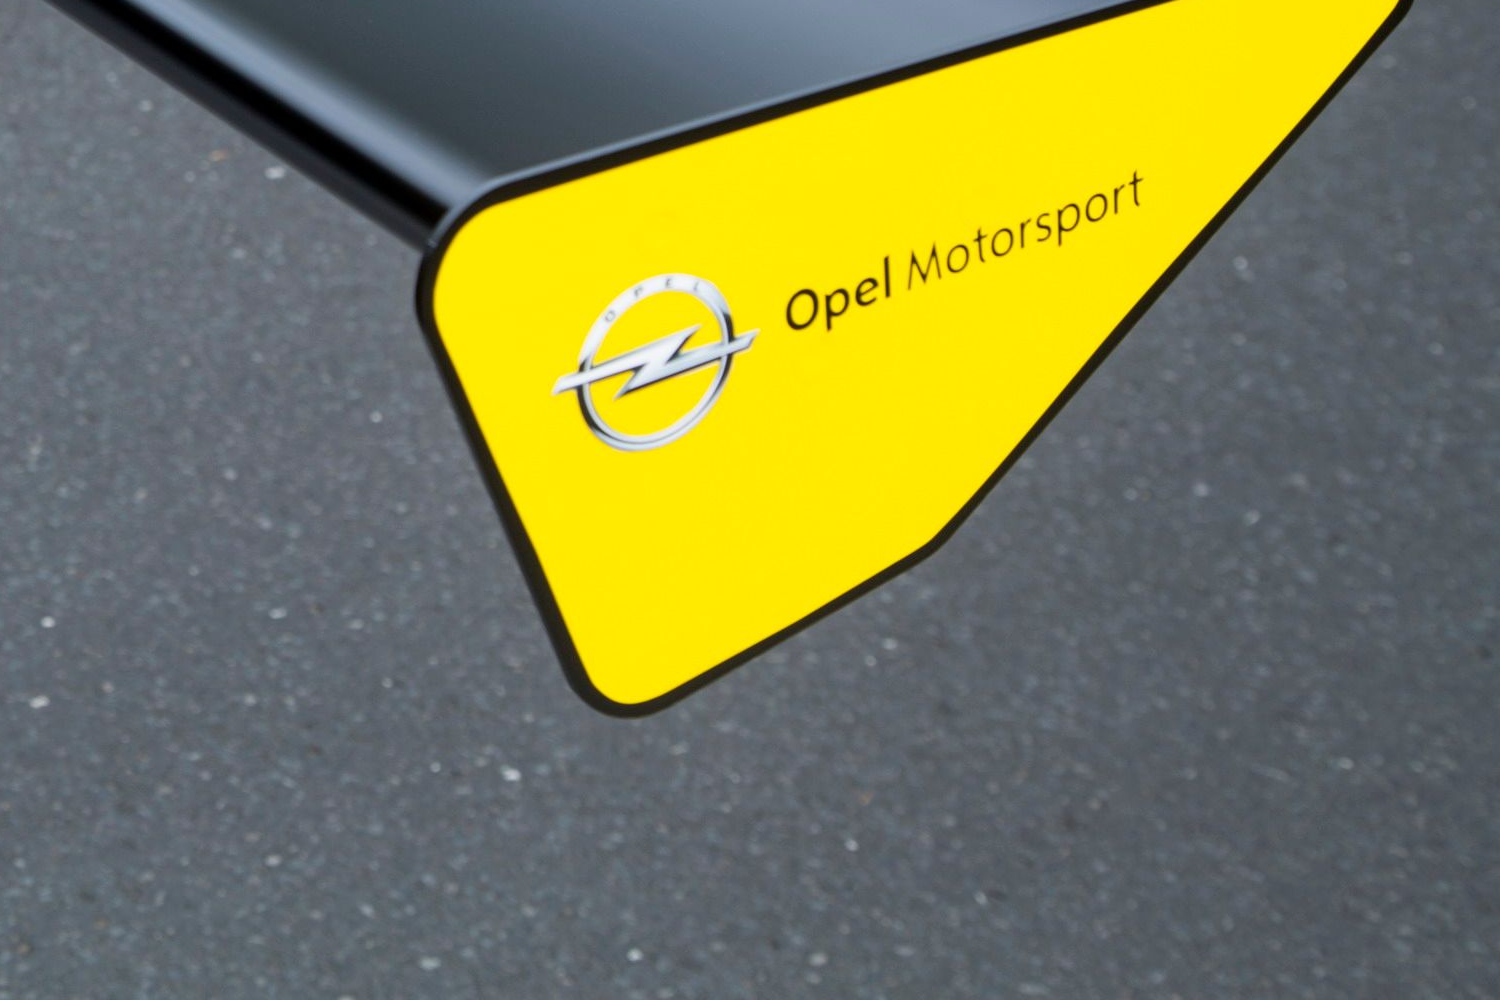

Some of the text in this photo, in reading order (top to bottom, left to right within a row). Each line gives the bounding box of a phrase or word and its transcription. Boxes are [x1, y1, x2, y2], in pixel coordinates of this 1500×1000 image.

[604, 276, 701, 323] OPEL
[785, 170, 1145, 332] Opel Motorsport
